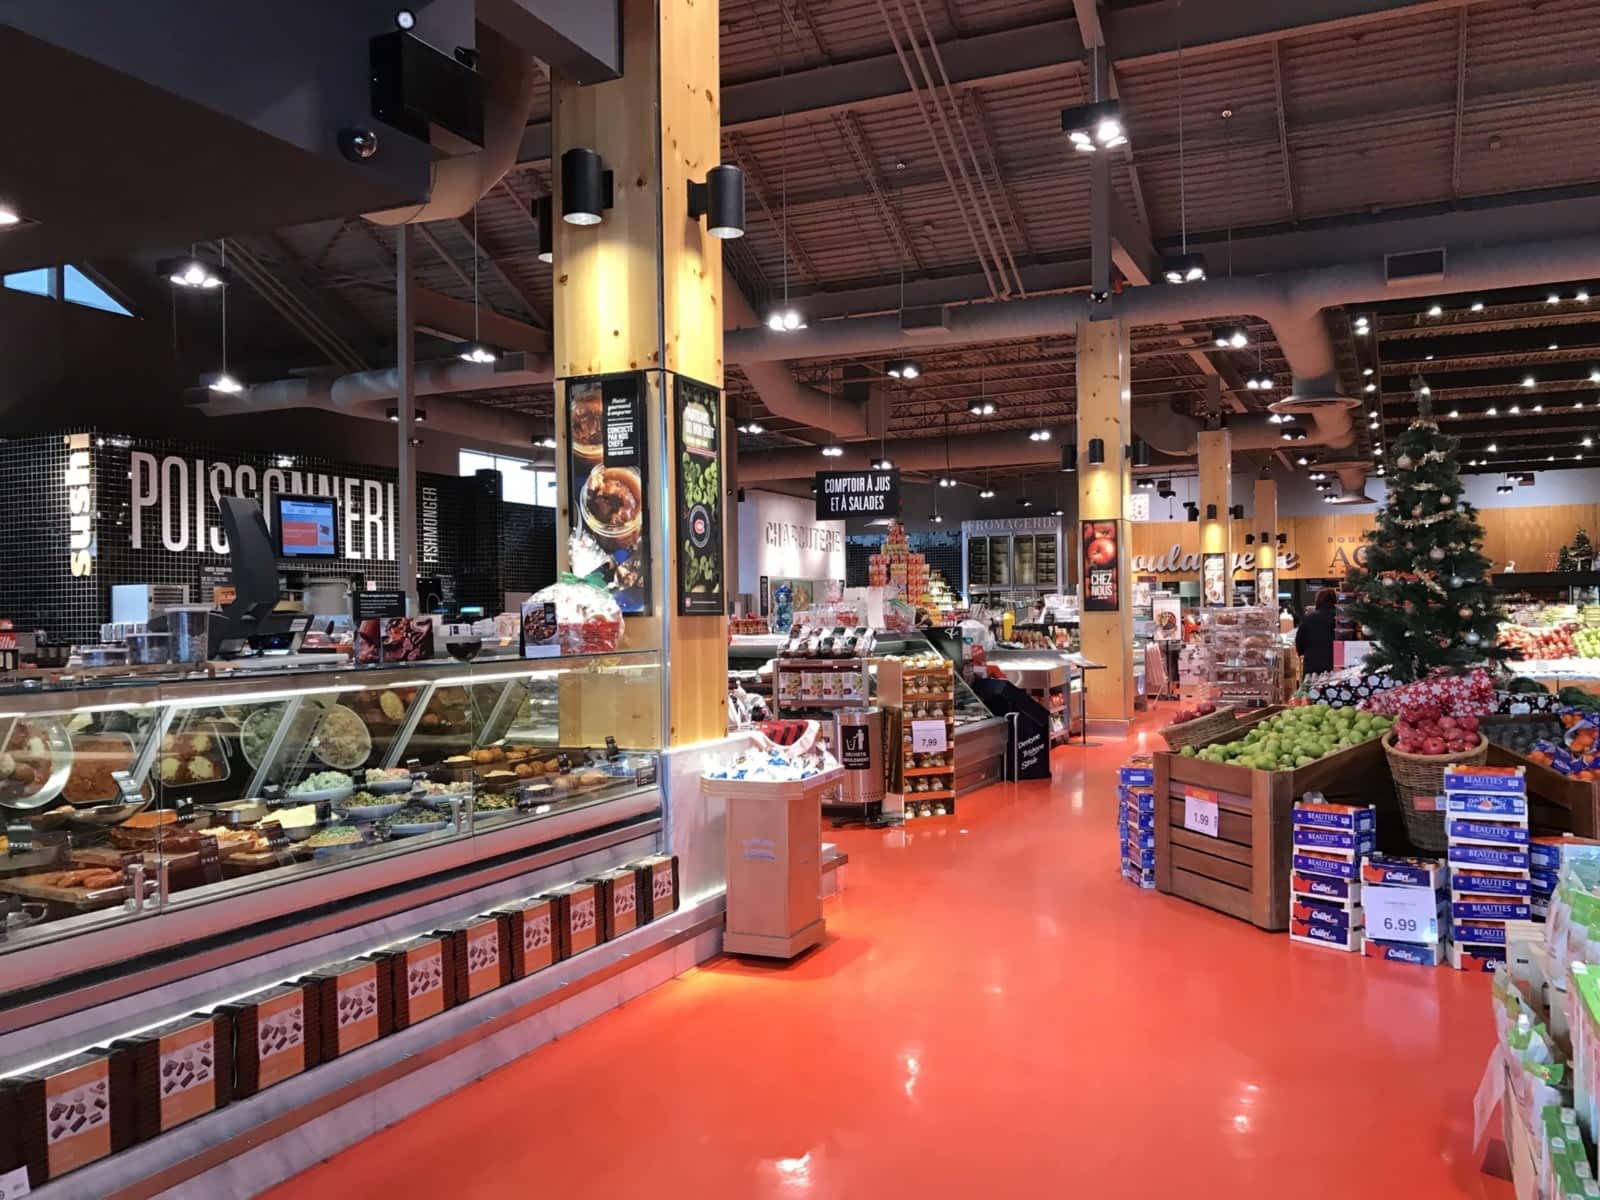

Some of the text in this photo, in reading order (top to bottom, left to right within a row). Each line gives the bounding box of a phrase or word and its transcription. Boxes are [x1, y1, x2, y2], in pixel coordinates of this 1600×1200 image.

[608, 440, 624, 448] CHEFS
[825, 474, 891, 493] COMPTOIR À JUS
[64, 433, 91, 577] sushi
[831, 494, 885, 512] ET À SALADES
[423, 487, 439, 563] FISHMONGER
[966, 517, 1057, 531] FROMAGERIE
[766, 522, 841, 552] CHARCUTERIE
[1091, 573, 1113, 585] CHEZ
[1464, 776, 1503, 785] BEAUTIES
[1194, 812, 1209, 826] 1.99
[1307, 812, 1338, 822] BEAUTIES
[1470, 822, 1510, 836] BEAUTIES
[1308, 833, 1339, 842] BEAUTIES
[1308, 859, 1339, 869] BEAUTIES
[1471, 877, 1512, 887] BEAUTIES
[1472, 902, 1512, 912] BEAUTIES
[1384, 917, 1417, 932] 6.99
[1474, 928, 1505, 937] BEAUTI
